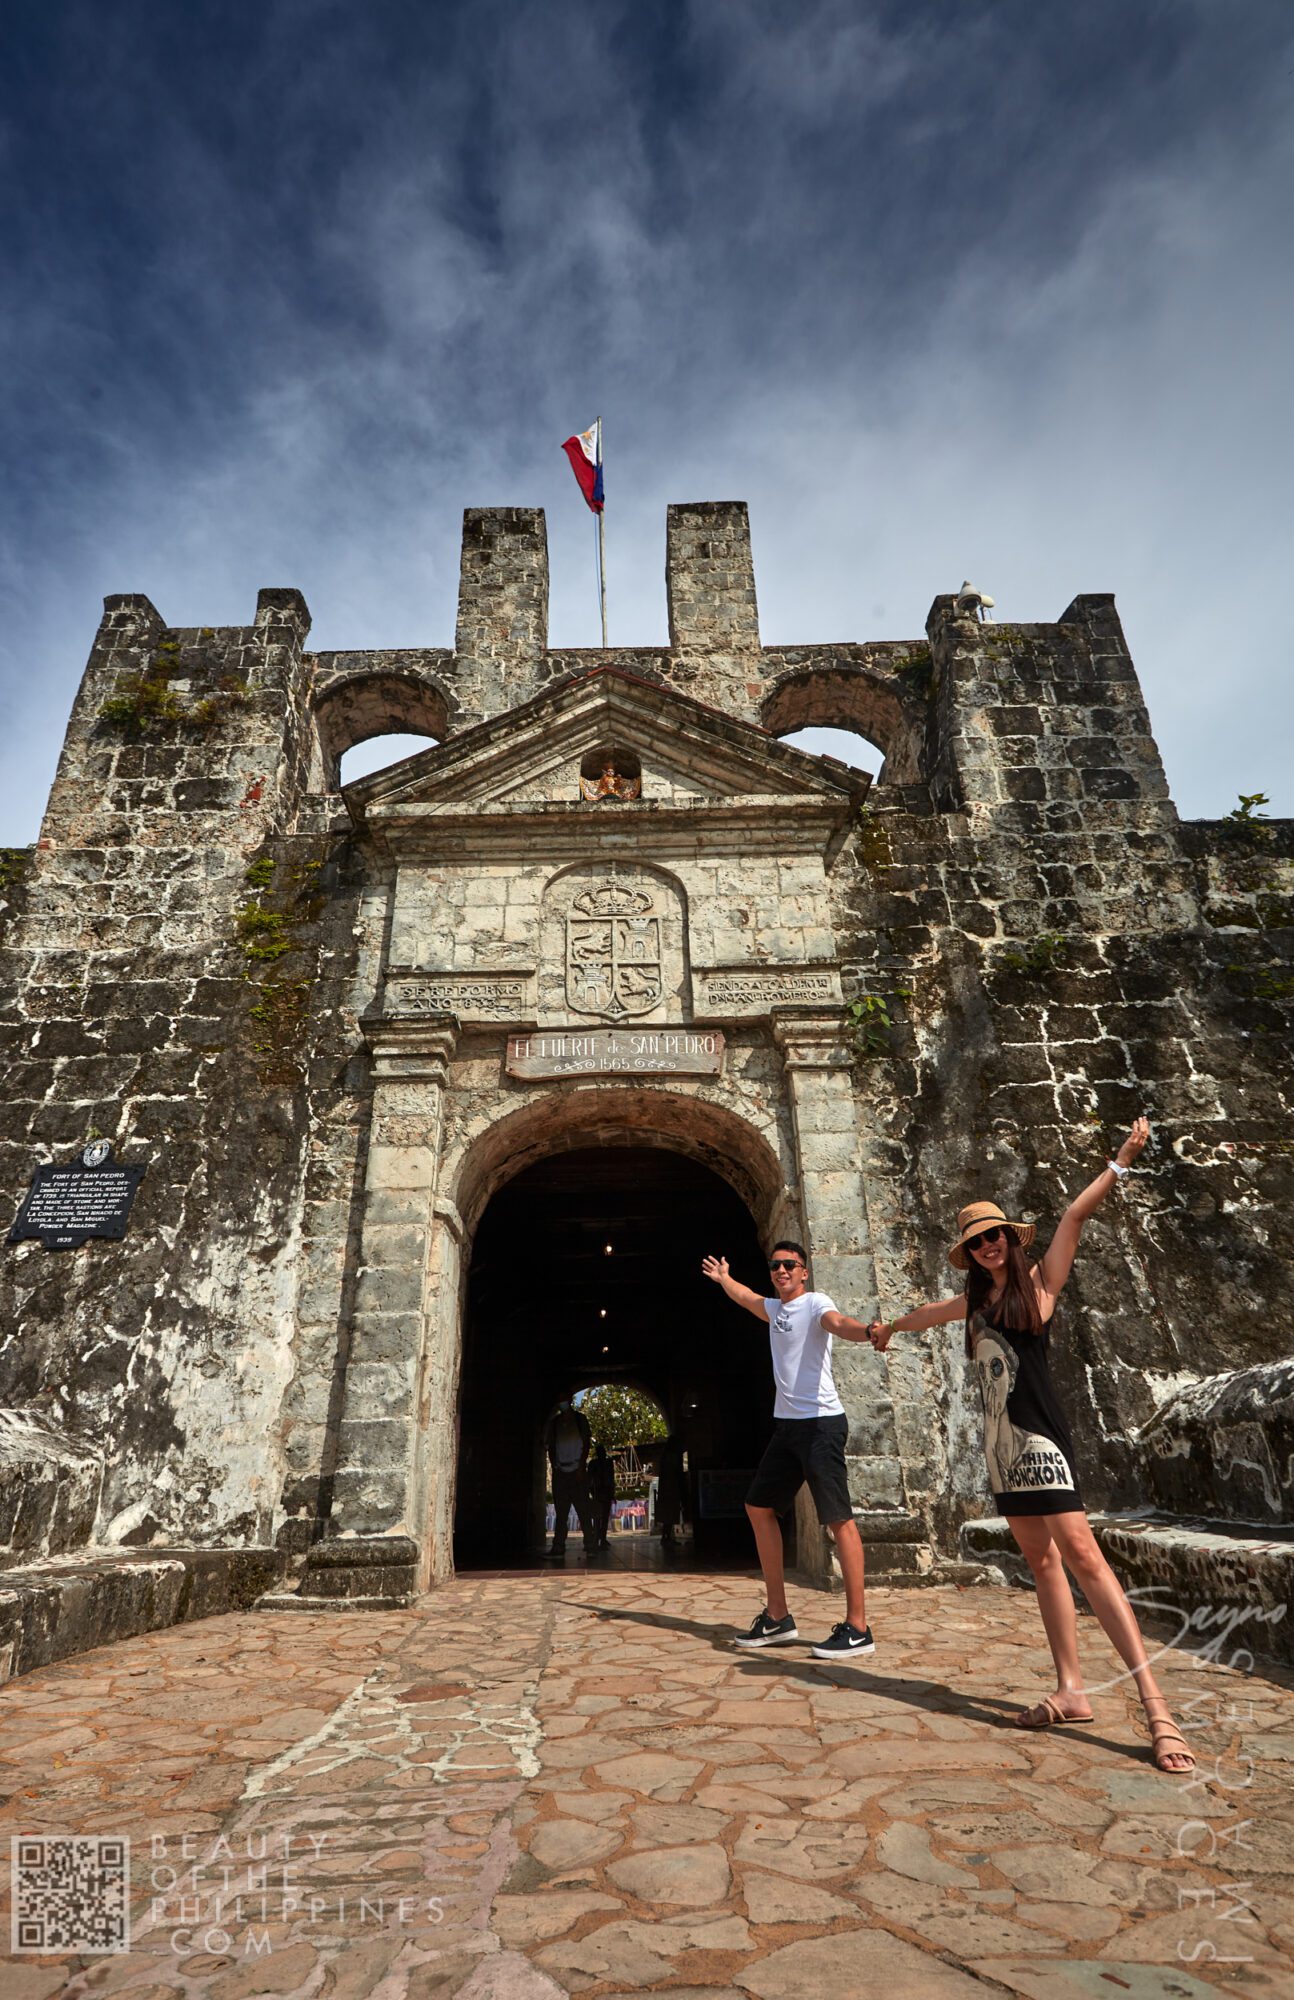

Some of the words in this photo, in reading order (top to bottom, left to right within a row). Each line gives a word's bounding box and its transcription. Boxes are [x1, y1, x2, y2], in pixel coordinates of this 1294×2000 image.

[515, 1039, 530, 1058] EL
[541, 1038, 600, 1057] FUERTE
[631, 1036, 659, 1054] SAN
[666, 1036, 715, 1054] PEDRO
[600, 1058, 629, 1070] 1565
